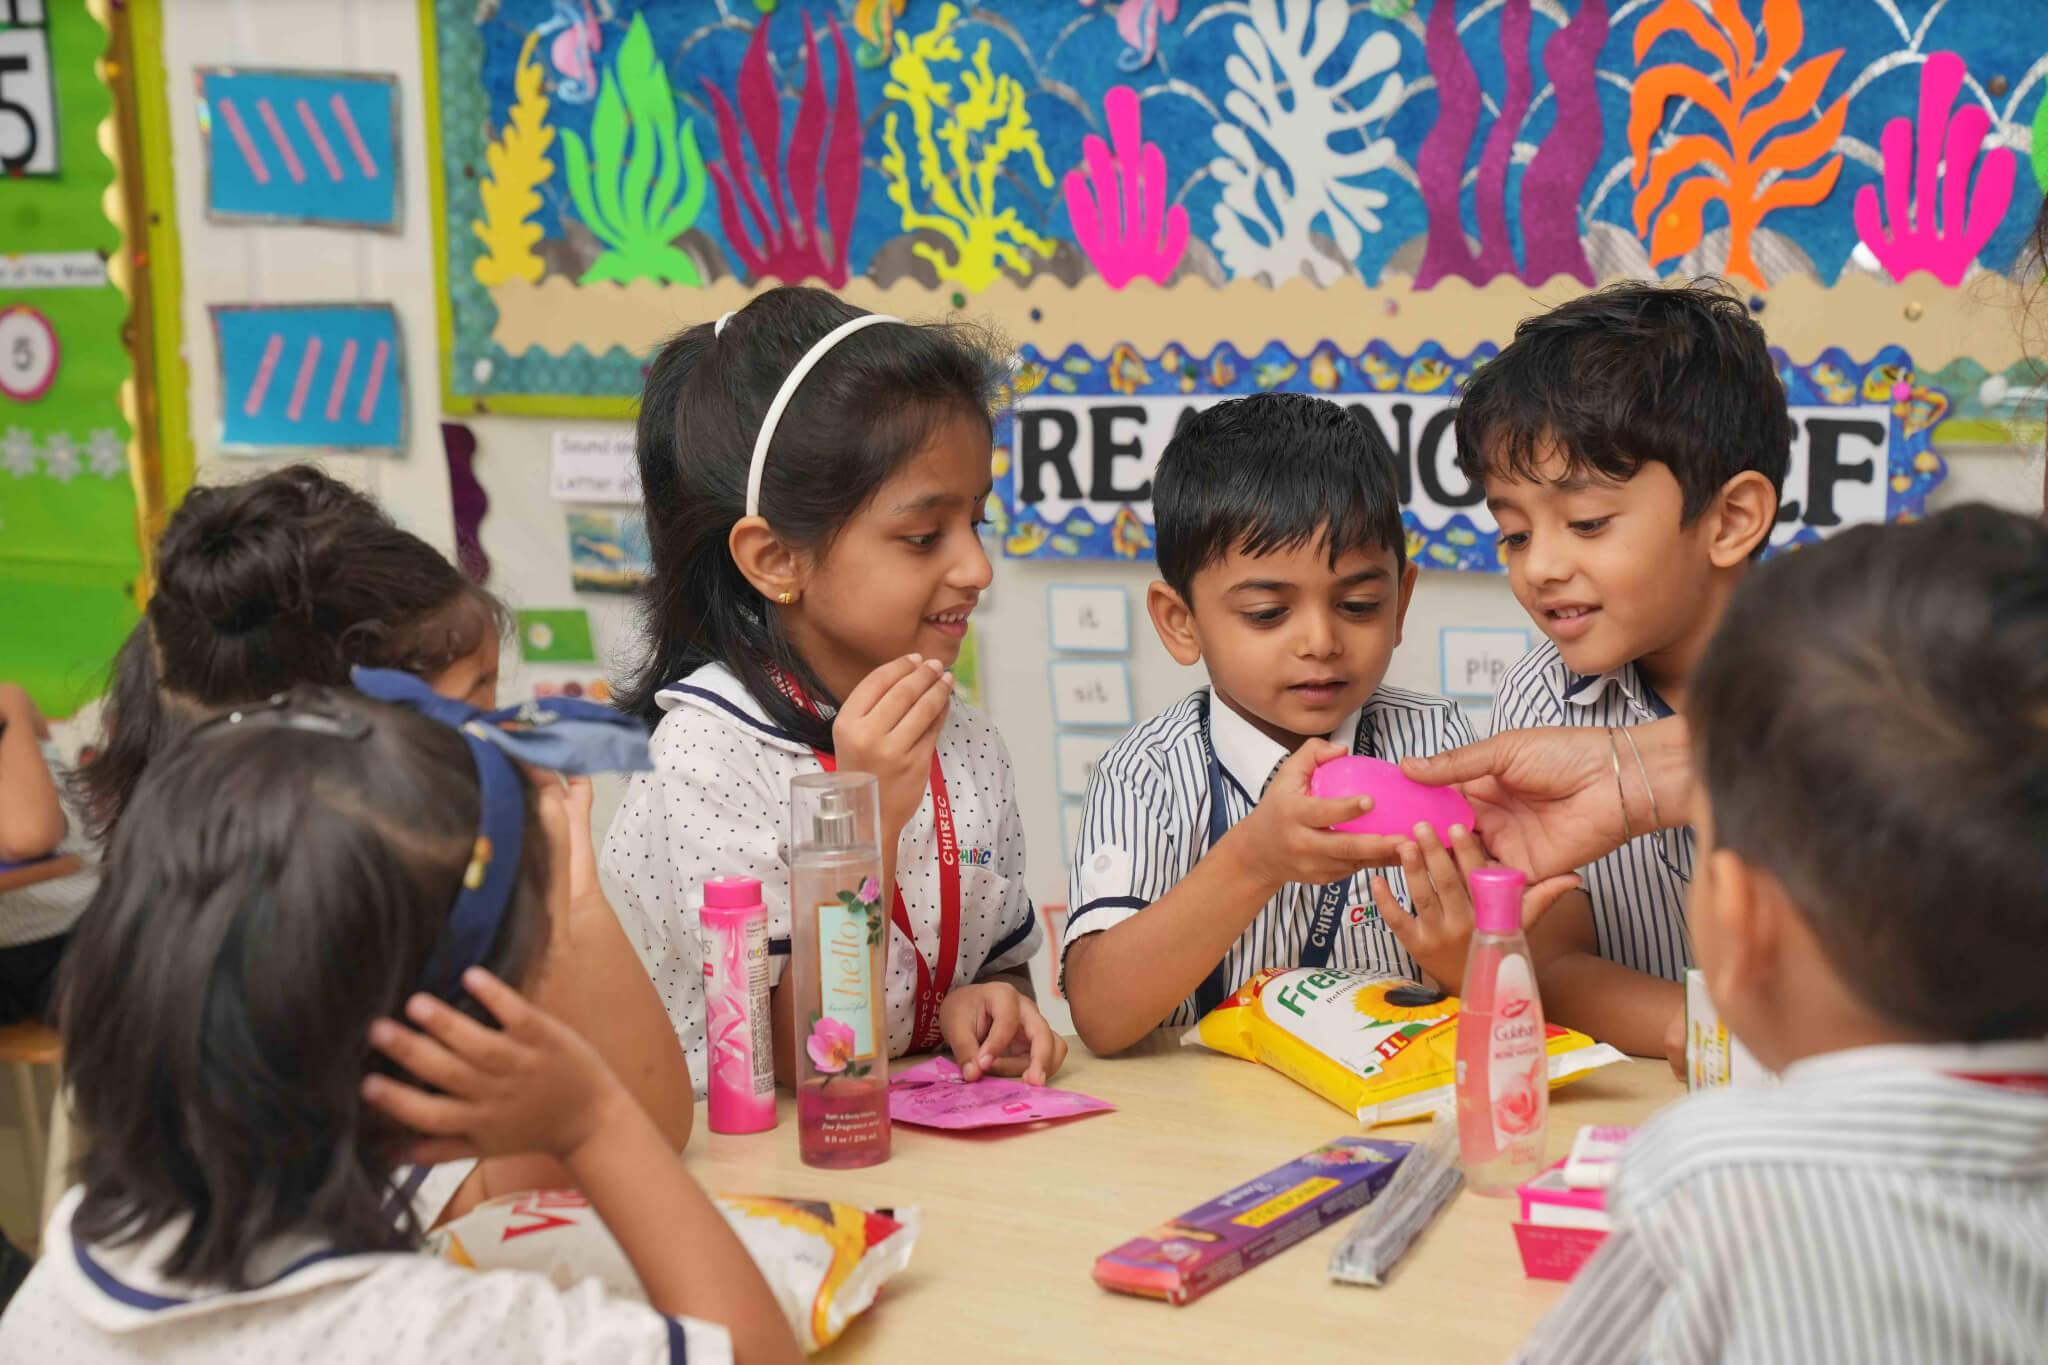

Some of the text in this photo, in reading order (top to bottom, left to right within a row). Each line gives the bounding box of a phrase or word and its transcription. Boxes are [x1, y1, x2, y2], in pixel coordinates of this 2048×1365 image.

[13, 335, 34, 374] 5
[1465, 650, 1504, 686] pip
[937, 794, 954, 866] CHIREC
[1312, 882, 1341, 948] CHIREC
[831, 920, 867, 1001] hello
[1380, 1035, 1408, 1058] 1L
